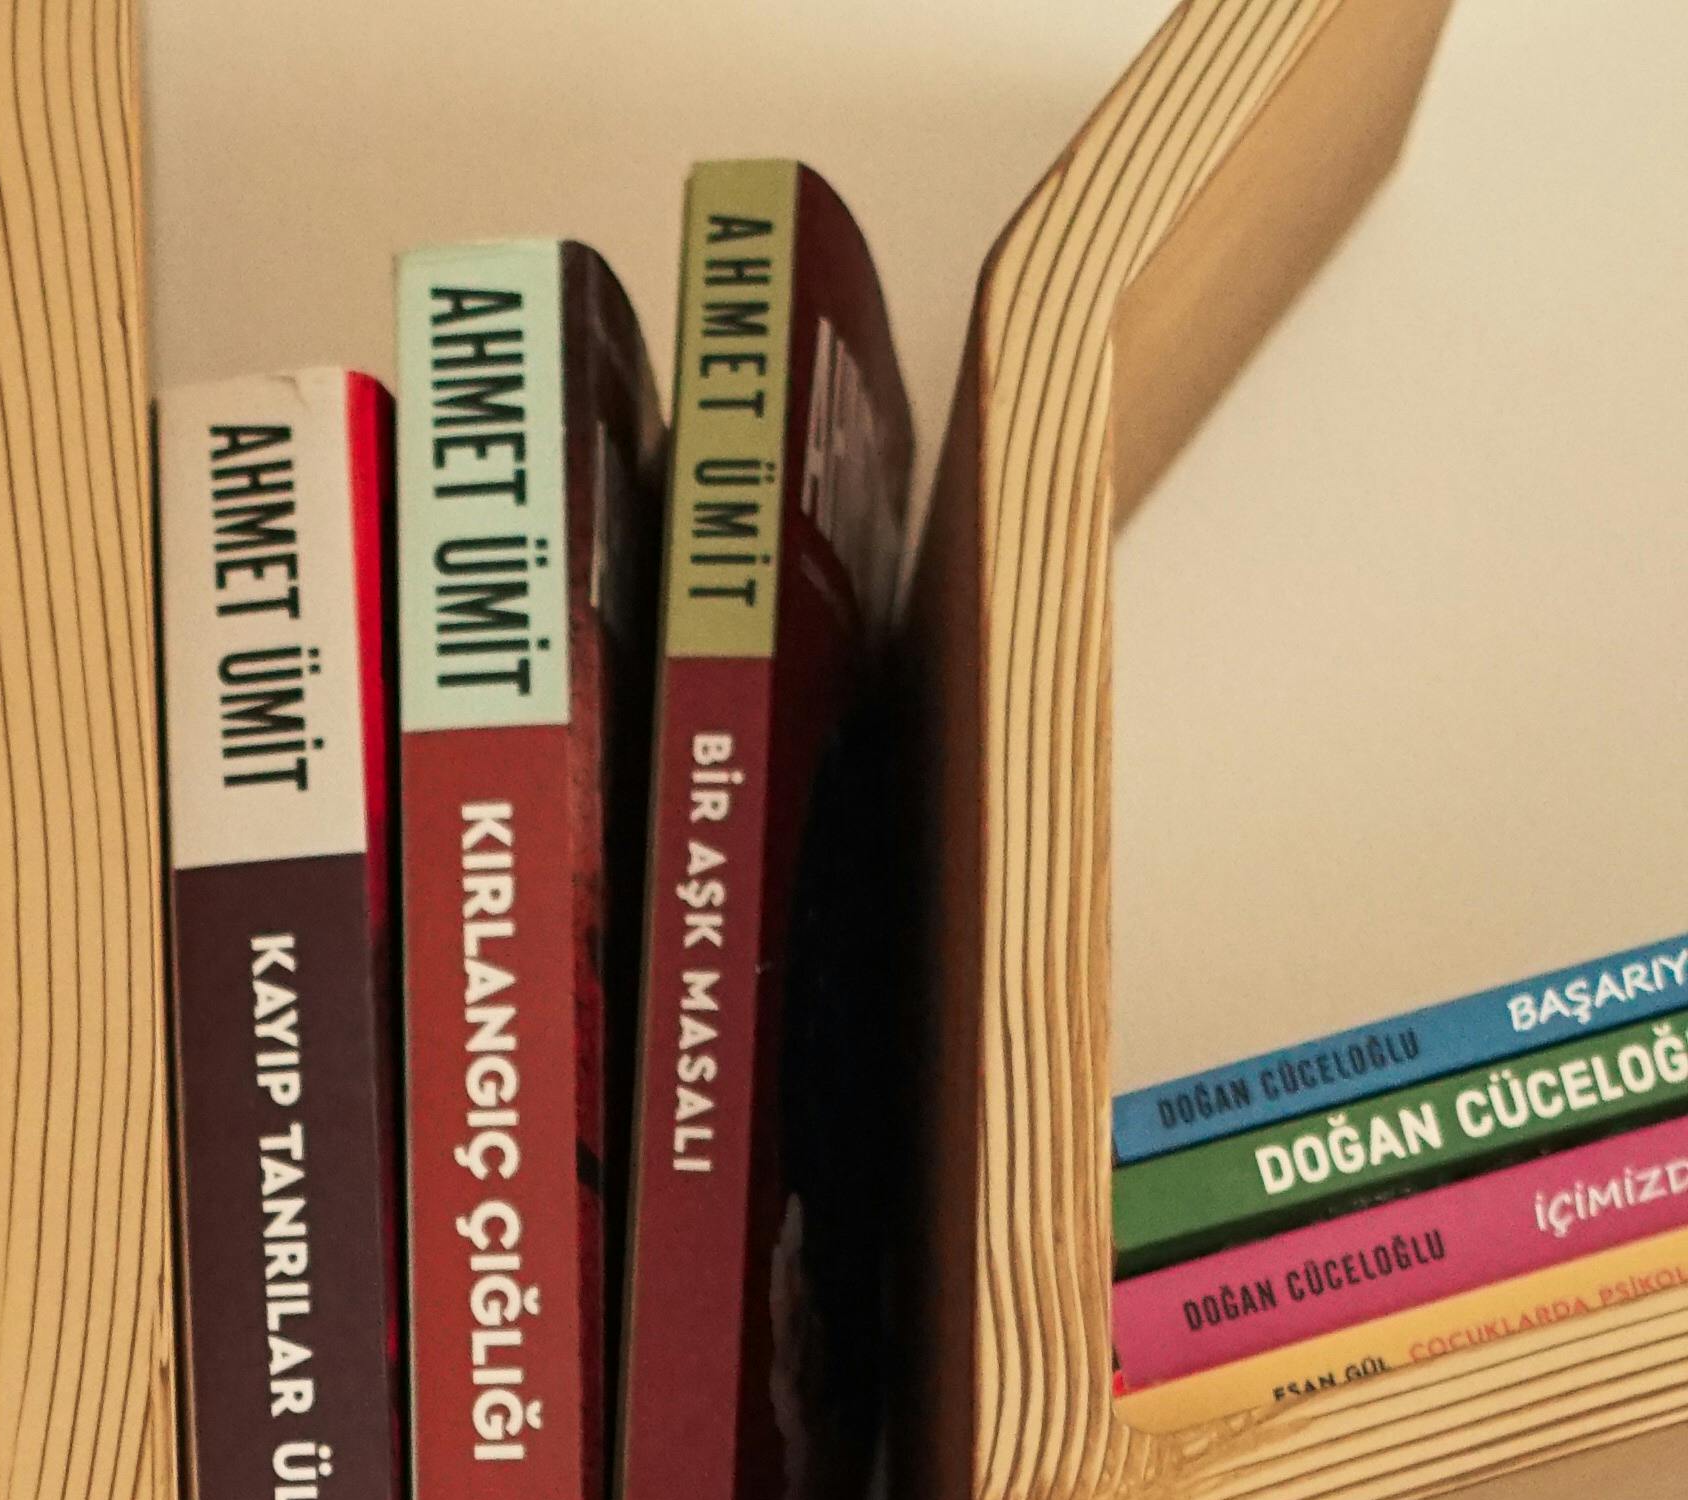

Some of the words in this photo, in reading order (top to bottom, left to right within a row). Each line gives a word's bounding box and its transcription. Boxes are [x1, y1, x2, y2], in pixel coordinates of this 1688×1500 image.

[429, 285, 528, 506] AHMET
[697, 211, 773, 420] AHMET
[208, 422, 301, 620] AHMET
[686, 457, 776, 608] ÜMİT
[431, 534, 550, 698] ÜMİT
[216, 647, 325, 794] ÜMİT
[688, 731, 745, 823] BİR
[675, 840, 728, 950] AŞK
[249, 932, 304, 1109] KAYIP
[454, 800, 522, 1182] KIRLANGIÇ
[671, 969, 722, 1174] MASALI
[1254, 1101, 1444, 1196] DOĞAN
[1455, 1021, 1688, 1138] CÜCELOĞ
[258, 1121, 316, 1418] TANRILAR
[454, 1201, 543, 1462] ÇIĞLIĞI
[1182, 1274, 1278, 1333] DOĞAN
[1284, 1228, 1448, 1304] CÜCELOĞLU
